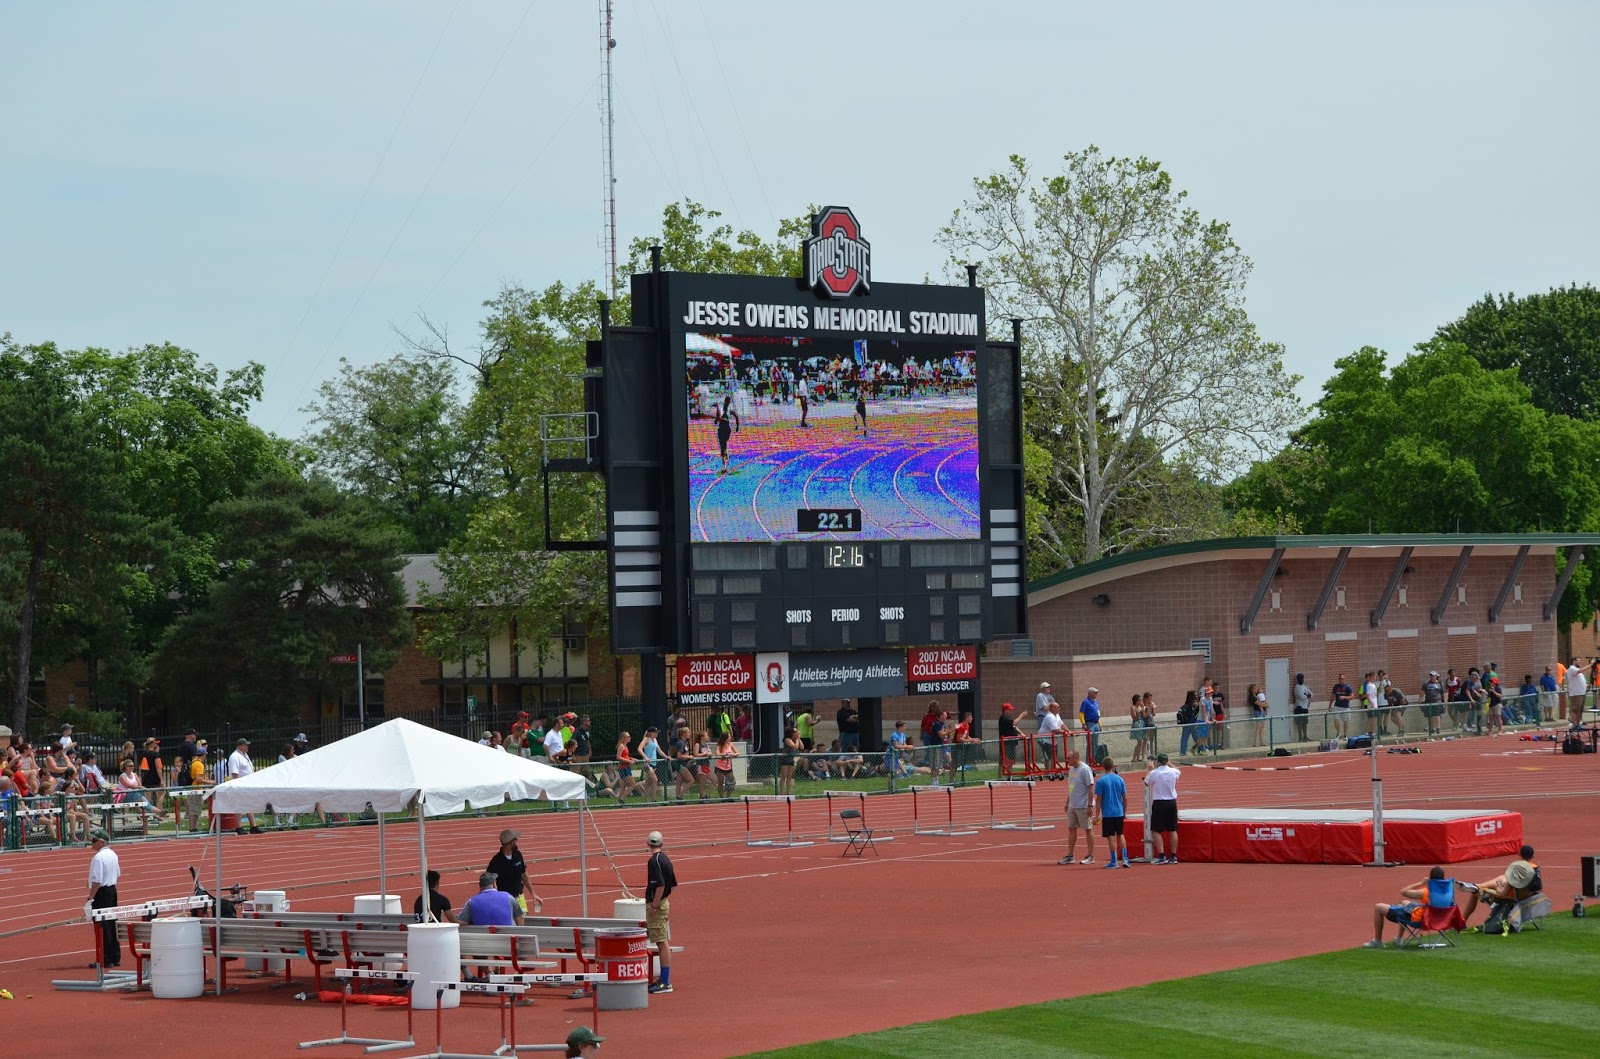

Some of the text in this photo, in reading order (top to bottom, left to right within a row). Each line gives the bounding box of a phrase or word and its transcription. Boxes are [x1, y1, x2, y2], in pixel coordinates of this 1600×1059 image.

[809, 232, 870, 290] OHIO STATE
[682, 301, 978, 336] JESSE OWENS MEMORIAL STADIUM
[817, 512, 853, 529] 22.1
[829, 546, 863, 567] 12:16
[786, 609, 812, 623] SHOTS
[831, 608, 860, 622] PERIOD
[880, 606, 905, 620] SHOTS
[919, 649, 966, 663] 2007 NCAA
[690, 659, 742, 673] 2010 NCAA
[912, 661, 973, 676] COLLEGE CUP
[682, 671, 750, 687] COLLEGE CUP
[792, 667, 828, 682] Athletes
[830, 665, 863, 682] Helping
[917, 680, 969, 692] MEN'S SOCCER
[681, 691, 753, 705] WOMEN'S SOCCER
[1246, 827, 1283, 838] UCS
[1474, 820, 1496, 834] UCS
